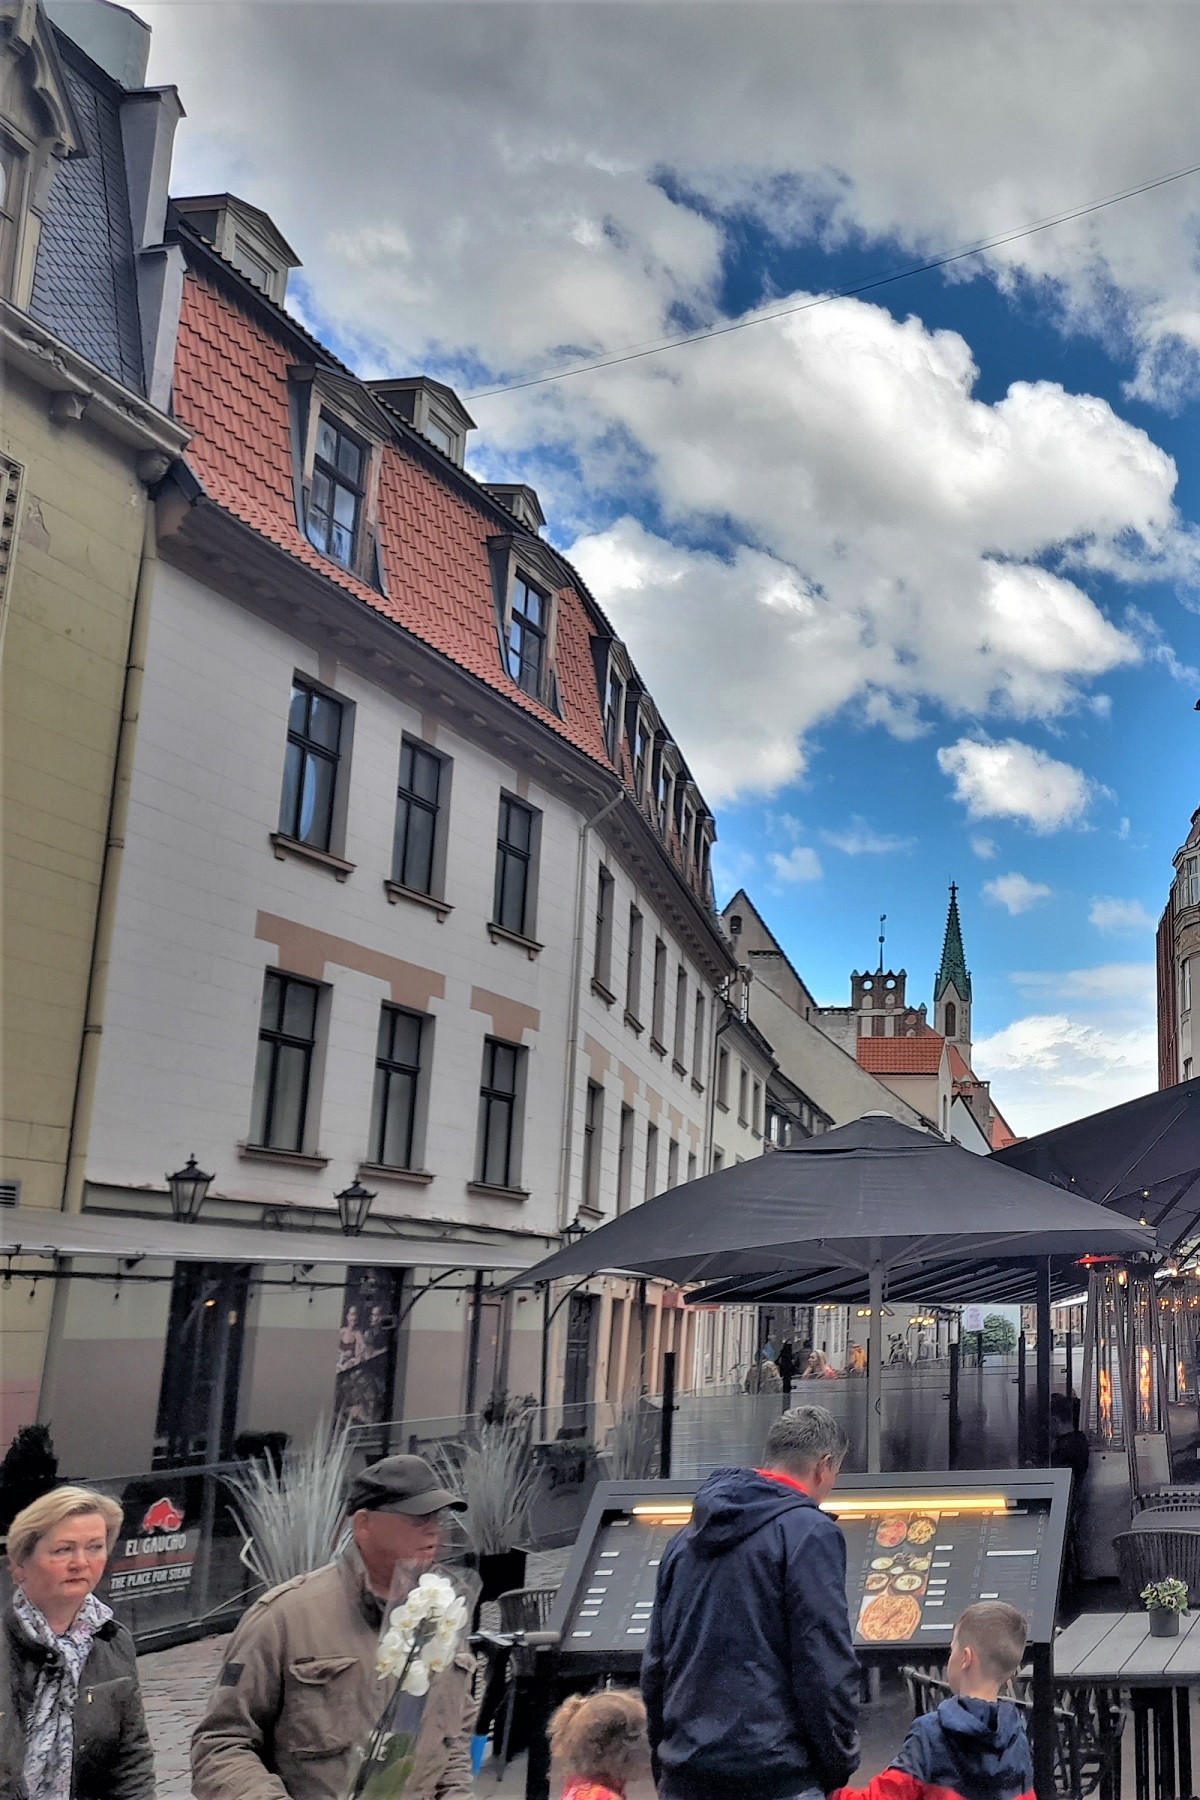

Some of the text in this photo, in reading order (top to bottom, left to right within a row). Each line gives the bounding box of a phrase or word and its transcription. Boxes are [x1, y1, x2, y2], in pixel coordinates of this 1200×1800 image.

[125, 1533, 187, 1556] EL GAUCHO
[111, 1577, 126, 1589] THE
[127, 1572, 152, 1586] PLACE
[152, 1569, 168, 1583] FOR
